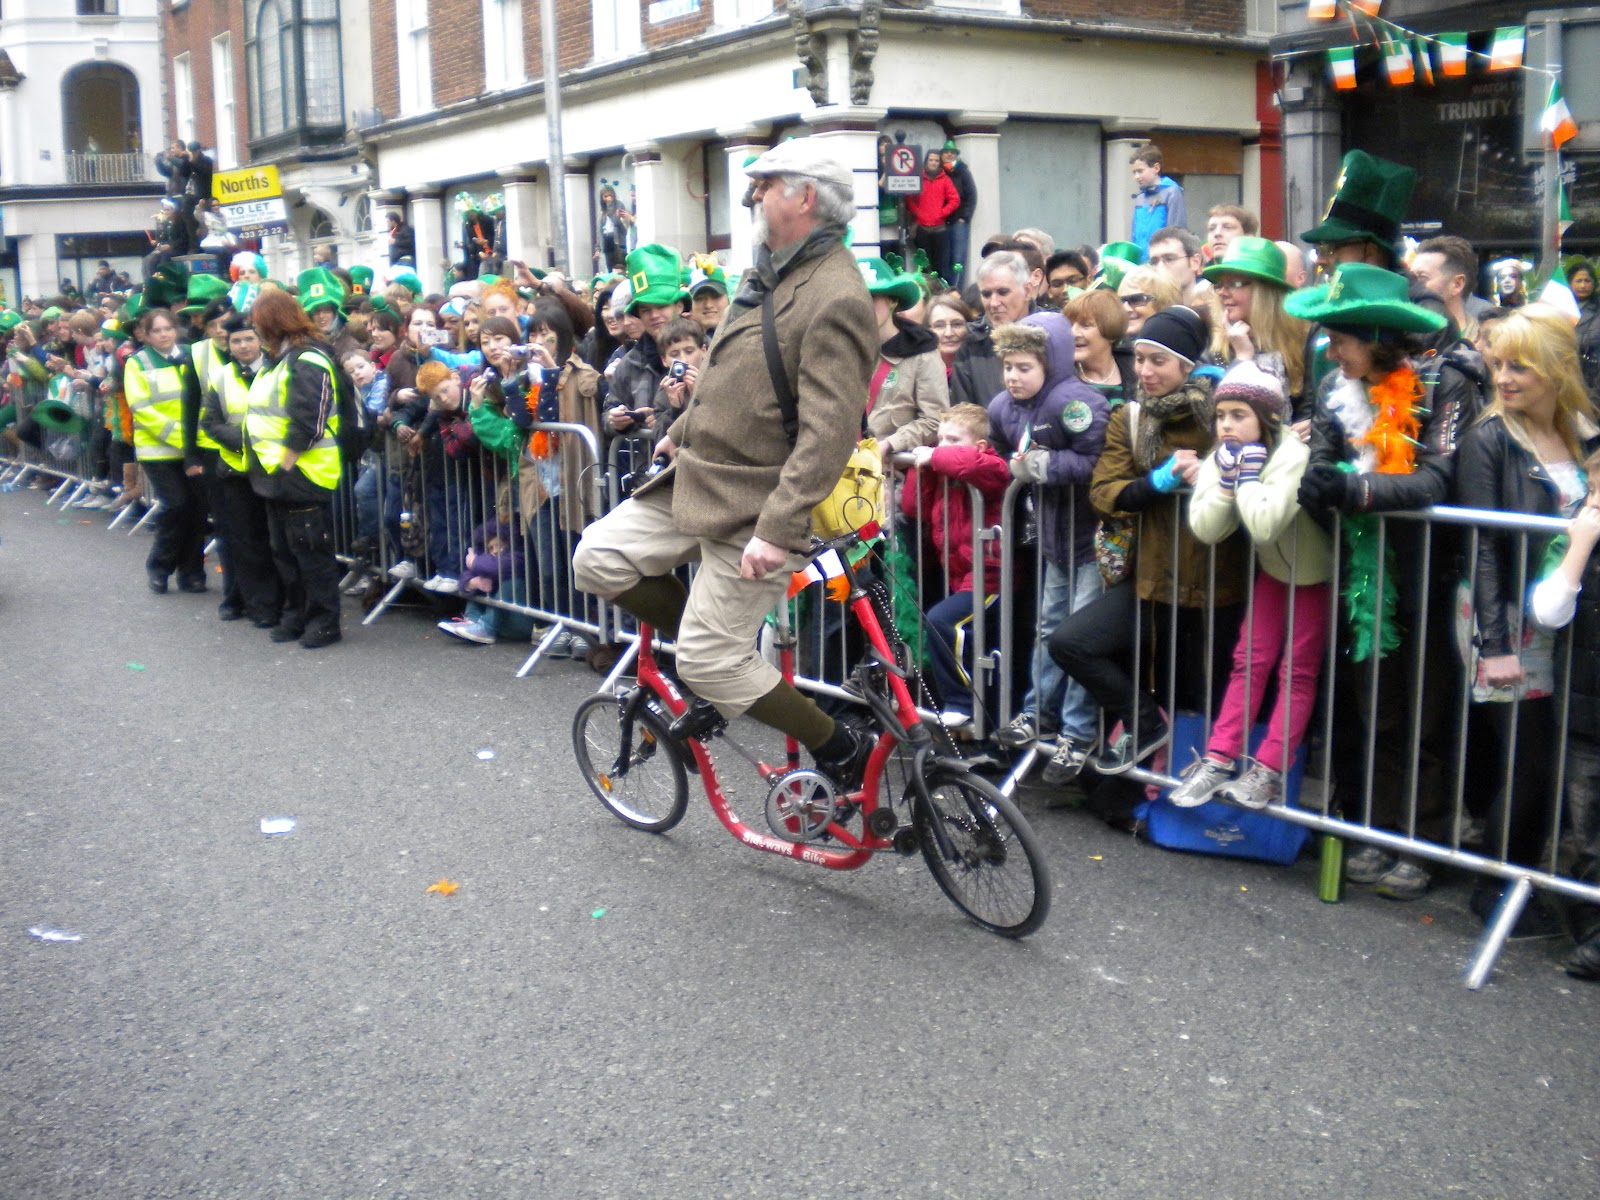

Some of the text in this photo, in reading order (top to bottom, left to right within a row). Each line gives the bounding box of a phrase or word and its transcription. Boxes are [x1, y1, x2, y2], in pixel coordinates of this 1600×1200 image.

[1438, 99, 1511, 121] TRINITY
[220, 175, 269, 194] Norths
[229, 203, 269, 215] TO LET
[239, 230, 256, 239] 433
[257, 228, 269, 236] 22
[271, 226, 283, 234] 22
[802, 850, 826, 865] Bike
